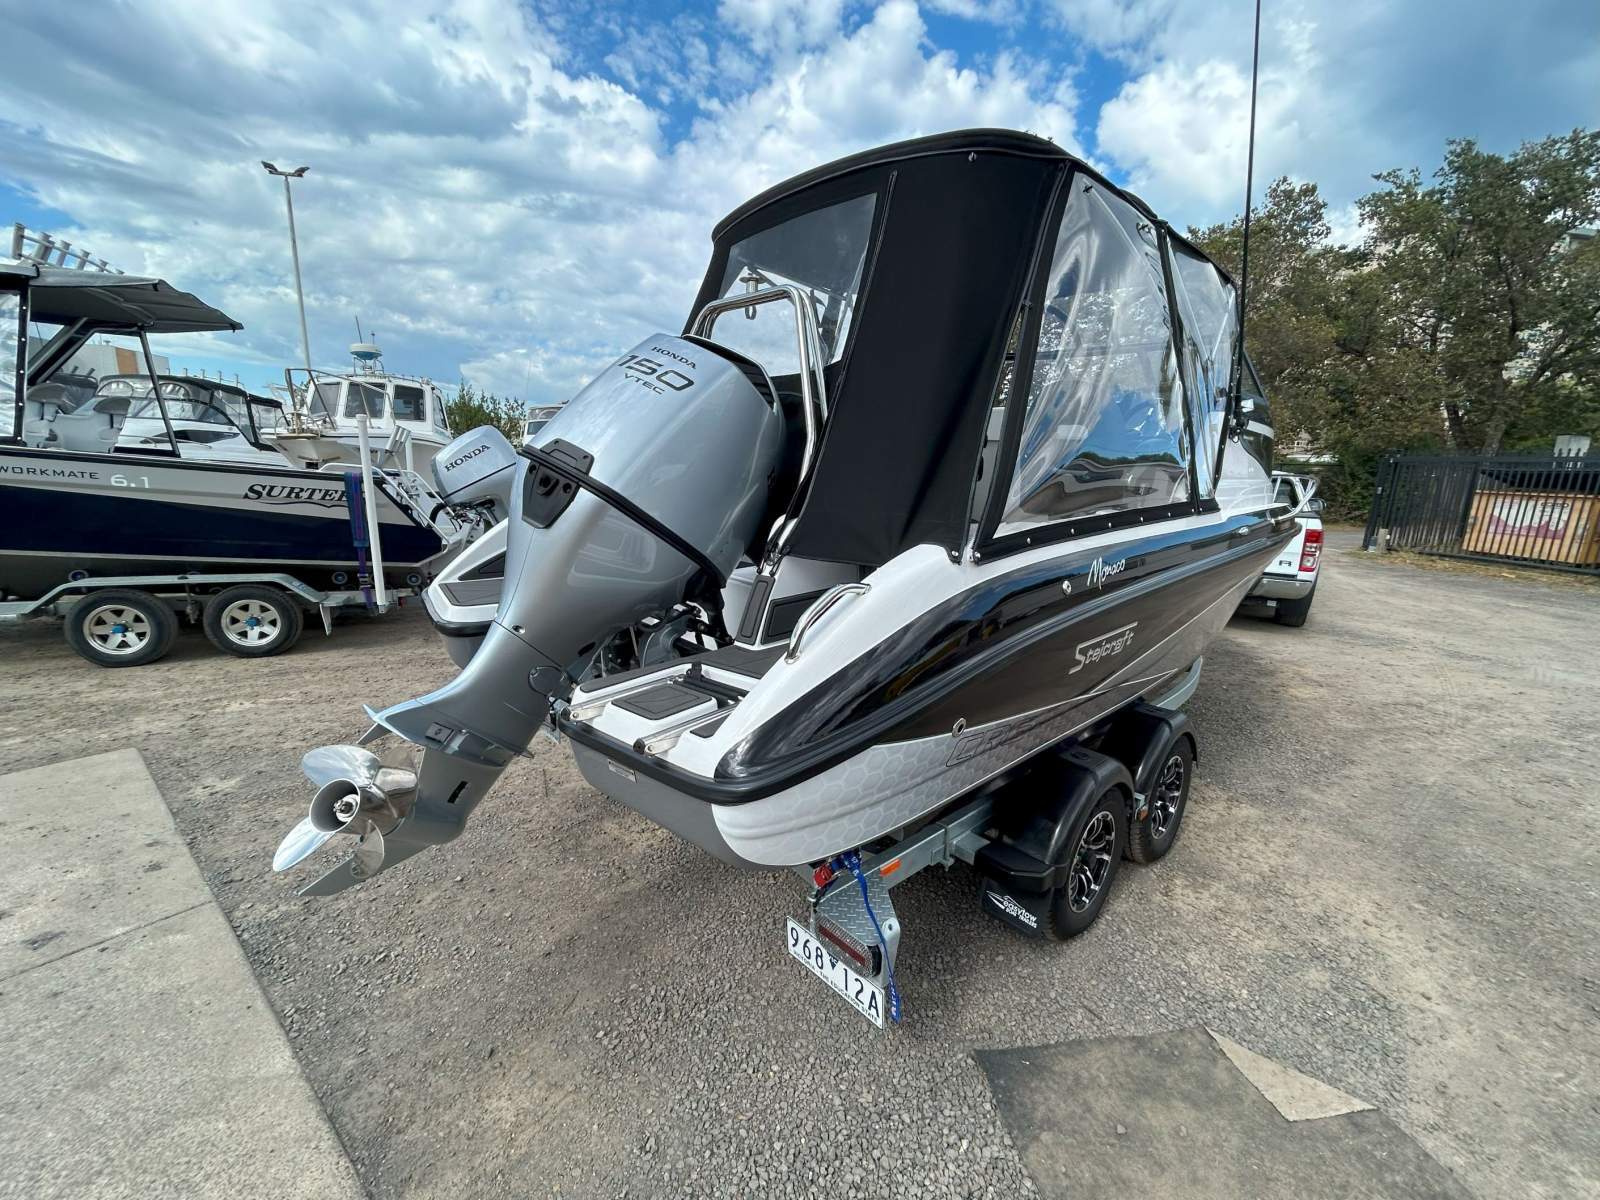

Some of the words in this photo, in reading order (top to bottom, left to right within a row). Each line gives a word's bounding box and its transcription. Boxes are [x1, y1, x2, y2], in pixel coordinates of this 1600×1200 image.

[651, 346, 697, 370] HONDA
[618, 354, 695, 392] 150
[624, 372, 665, 395] VTEC
[444, 444, 491, 472] HONDA
[0, 466, 100, 480] WORKMATE
[110, 474, 150, 489] 6.1
[1086, 557, 1126, 590] Monaco
[790, 926, 824, 970] 968
[843, 967, 880, 1018] 12A
